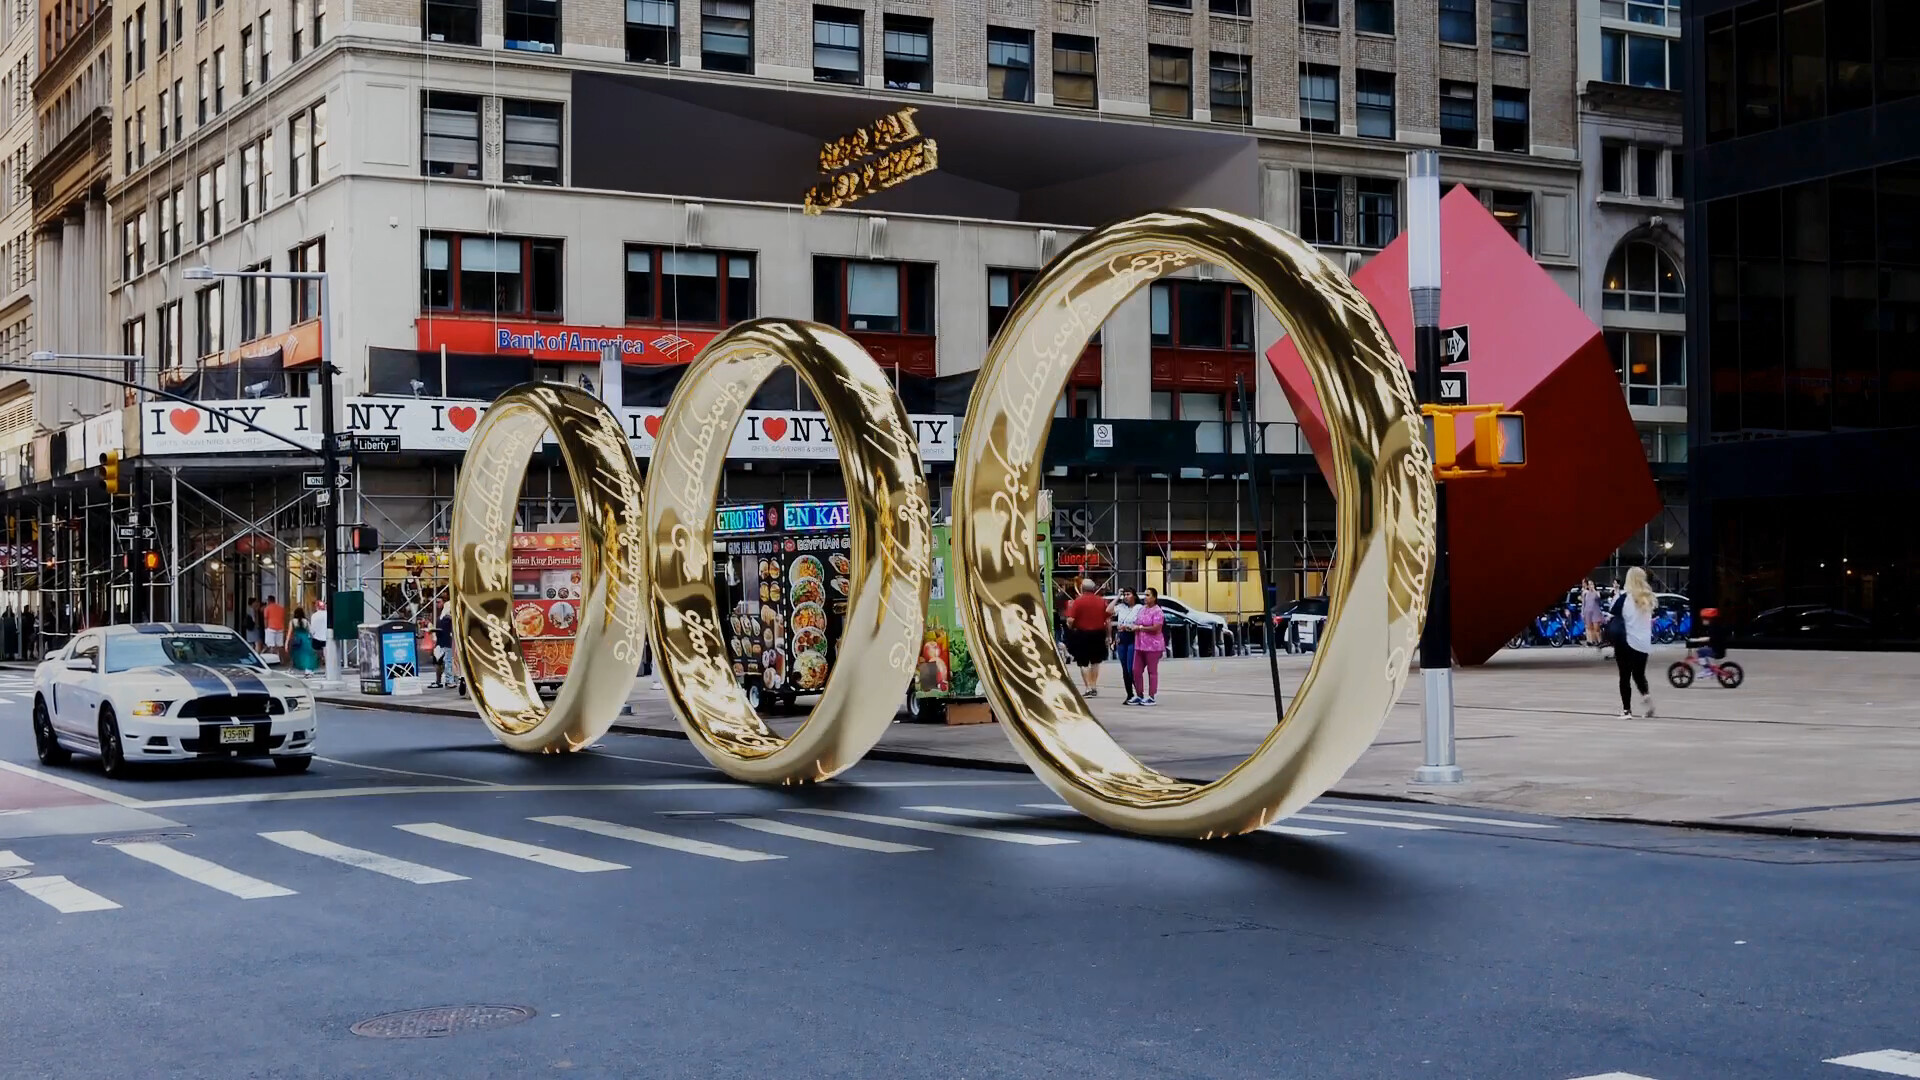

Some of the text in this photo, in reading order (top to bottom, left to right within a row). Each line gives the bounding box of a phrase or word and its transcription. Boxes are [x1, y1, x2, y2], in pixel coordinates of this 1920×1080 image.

[497, 328, 546, 350] Bank
[547, 331, 568, 351] of
[151, 406, 266, 435] I NY
[347, 403, 405, 430] NY
[431, 405, 445, 431] I
[628, 414, 642, 440] I
[747, 416, 833, 442] I NY
[359, 439, 390, 452] Liberty
[717, 511, 744, 529] GYRO
[785, 507, 809, 527] EN
[797, 537, 840, 551] EGYPTIAN
[512, 555, 530, 564] ndian
[531, 556, 547, 566] King
